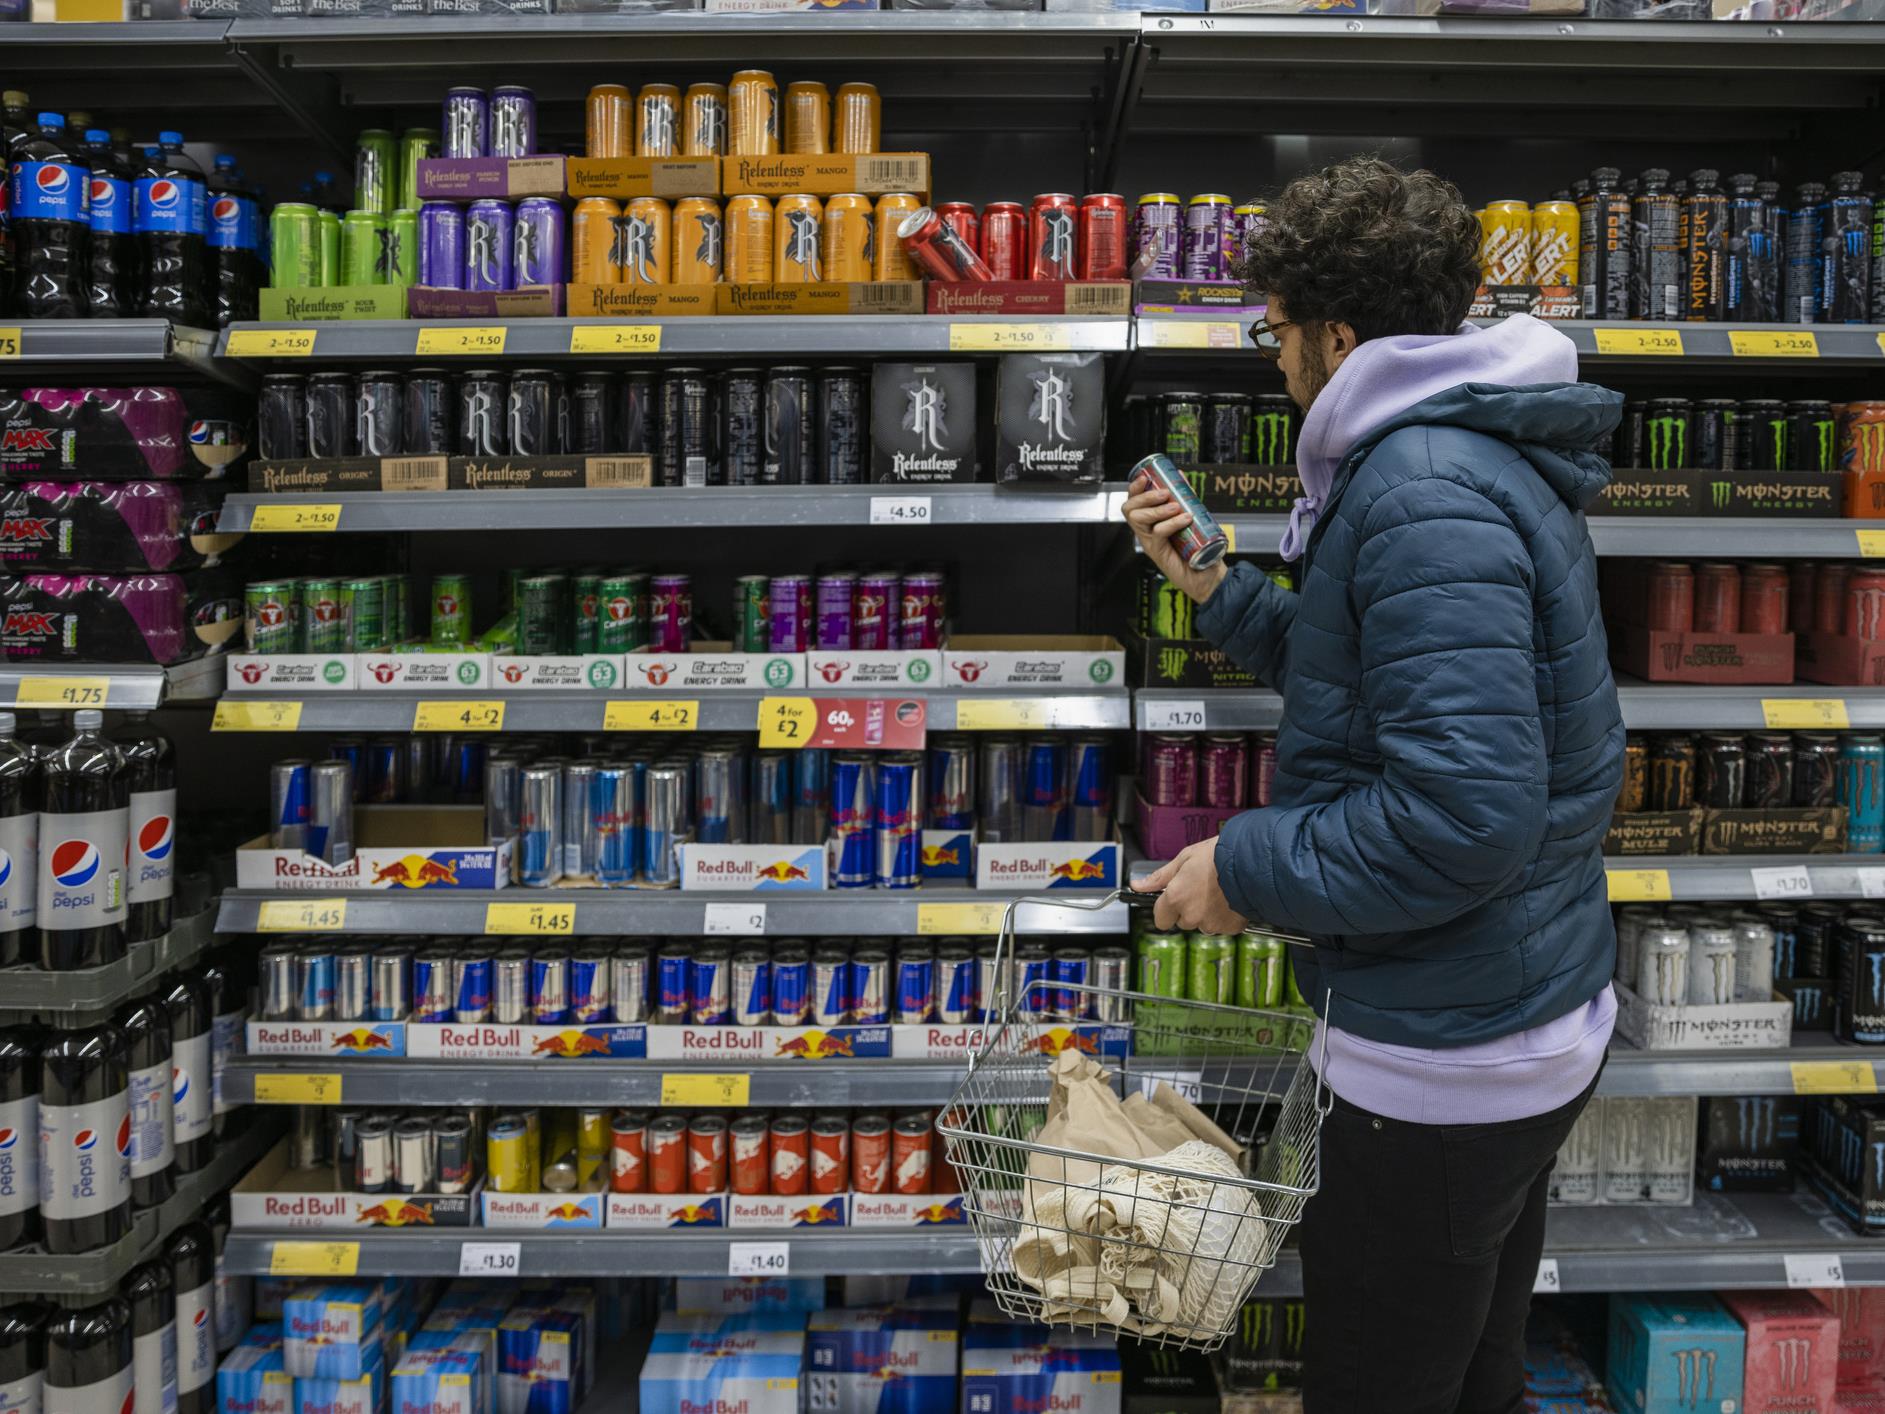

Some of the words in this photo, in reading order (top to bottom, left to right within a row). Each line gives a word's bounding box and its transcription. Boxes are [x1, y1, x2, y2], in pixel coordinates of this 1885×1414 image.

[392, 3, 422, 11] DRINKS
[510, 1, 541, 9] DRINKS
[718, 2, 756, 10] ENERGY
[759, 2, 788, 10] DRINK
[425, 168, 471, 188] Relentless
[576, 169, 620, 187] Relentless
[739, 159, 806, 188] Relentless
[816, 167, 847, 175] MANGO
[39, 196, 66, 205] pepsi
[151, 210, 176, 218] pepsi
[1692, 209, 1708, 309] MONSTER
[593, 285, 658, 313] Relentless
[668, 295, 699, 303] MANGO
[731, 284, 798, 312] Relentless
[936, 289, 1004, 312] Relentless
[1015, 295, 1050, 304] CHERRY
[286, 294, 345, 320] Relentless
[1529, 303, 1581, 318] ALERT
[270, 339, 277, 347] 2
[285, 338, 309, 348] £1.50
[461, 336, 468, 345] 2
[476, 336, 501, 345] £1.50
[615, 334, 622, 343] 2
[630, 333, 656, 343] £1.50
[994, 332, 1000, 341] 2
[1009, 332, 1034, 341] £1.50
[1638, 338, 1645, 346] 2
[1652, 338, 1677, 347] £2.50
[1774, 340, 1781, 349] 2
[1787, 340, 1812, 349] £2.50
[6, 418, 32, 428] pepsi
[2, 428, 59, 451] MAX
[1018, 440, 1085, 471] Relentless
[892, 450, 959, 481] Relentless
[262, 464, 329, 493] Relentless
[339, 471, 369, 480] ORIGIN
[465, 460, 532, 490] Relentless
[543, 470, 573, 478] ORIGIN
[910, 473, 932, 481] ENERGY
[1601, 481, 1690, 499] MONSTER
[1736, 482, 1832, 501] MONSTER
[1753, 500, 1814, 508] ENERGY
[4, 508, 30, 518] pepsi
[295, 514, 302, 522] 2
[310, 513, 335, 522] £1.50
[890, 506, 927, 518] £4.50
[0, 518, 57, 540] MAX
[8, 602, 33, 612] pepsi
[2, 612, 60, 635] MAX
[460, 667, 476, 678] 63
[538, 665, 580, 677] Carabao
[592, 667, 612, 679] 63
[691, 662, 745, 675] Carabao
[768, 664, 787, 677] 63
[912, 664, 926, 676] 63
[1093, 664, 1109, 676] 63
[403, 675, 428, 683] ENERGY
[683, 677, 718, 685] ENERGY
[720, 677, 747, 685] DRINK
[852, 674, 876, 682] ENERGY
[878, 674, 899, 682] DRINK
[1007, 674, 1038, 682] ENERGY
[1040, 674, 1063, 682] DRINK
[62, 687, 103, 705] £1.75
[459, 709, 471, 723] 4
[484, 709, 499, 724] £2
[649, 710, 660, 722] 4
[674, 709, 689, 724] £2
[776, 705, 786, 716] 4
[787, 708, 803, 717] for
[827, 710, 854, 727] 60p
[1169, 712, 1202, 725] £1.70
[778, 720, 799, 737] £2
[1609, 825, 1682, 838] MONSTER
[1740, 820, 1819, 834] MONSTER
[1621, 839, 1668, 849] MULE
[697, 860, 726, 874] Red
[727, 859, 754, 874] Bull
[990, 860, 1017, 873] Red
[1019, 860, 1047, 873] Bull
[1777, 877, 1807, 891] £1.70
[52, 893, 95, 909] pepsi
[302, 909, 340, 927] £1.45
[530, 913, 569, 931] £1.45
[749, 915, 763, 928] £2
[1691, 1018, 1776, 1032] MONSTER
[258, 1028, 290, 1043] Red
[292, 1028, 322, 1043] Bull
[440, 1028, 481, 1047] Red
[484, 1028, 520, 1047] Bull
[683, 1031, 724, 1049] Red
[726, 1031, 763, 1049] Bull
[928, 1028, 967, 1047] Red
[440, 1050, 484, 1058] ENERGY
[488, 1050, 521, 1058] DRINK
[683, 1052, 726, 1060] ENERGY
[728, 1052, 763, 1060] DRINK
[1717, 1157, 1787, 1170] MONSTER
[77, 1153, 96, 1197] pepsi
[265, 1197, 305, 1216] Red
[307, 1197, 345, 1215] Bull
[490, 1201, 514, 1213] Red
[515, 1201, 540, 1213] Bull
[612, 1204, 634, 1215] Red
[637, 1204, 662, 1215] Bull
[734, 1205, 758, 1216] Red
[760, 1205, 784, 1216] Bull
[857, 1204, 881, 1215] Red
[883, 1204, 907, 1215] Bull
[288, 1217, 322, 1226] ZERO
[484, 1254, 515, 1269] £1.30
[752, 1254, 785, 1269] £1.40
[1543, 1271, 1556, 1285] £5
[1828, 1265, 1841, 1280] £5
[292, 1317, 320, 1334] Red
[322, 1317, 349, 1334] Bull
[690, 1338, 722, 1349] Red
[724, 1338, 757, 1349] Bull
[507, 1355, 533, 1374] Red
[534, 1355, 562, 1374] Bull
[853, 1352, 887, 1367] Red
[889, 1352, 918, 1367] Bull
[227, 1398, 255, 1413] Red
[257, 1398, 284, 1413] Bull
[303, 1403, 330, 1414] Red
[334, 1403, 362, 1414] Bull
[402, 1401, 430, 1414] Red
[432, 1401, 461, 1414] Bull
[680, 1400, 713, 1414] Red
[716, 1400, 748, 1414] Bull
[1013, 1394, 1046, 1410] Red
[1050, 1394, 1082, 1410] Bull
